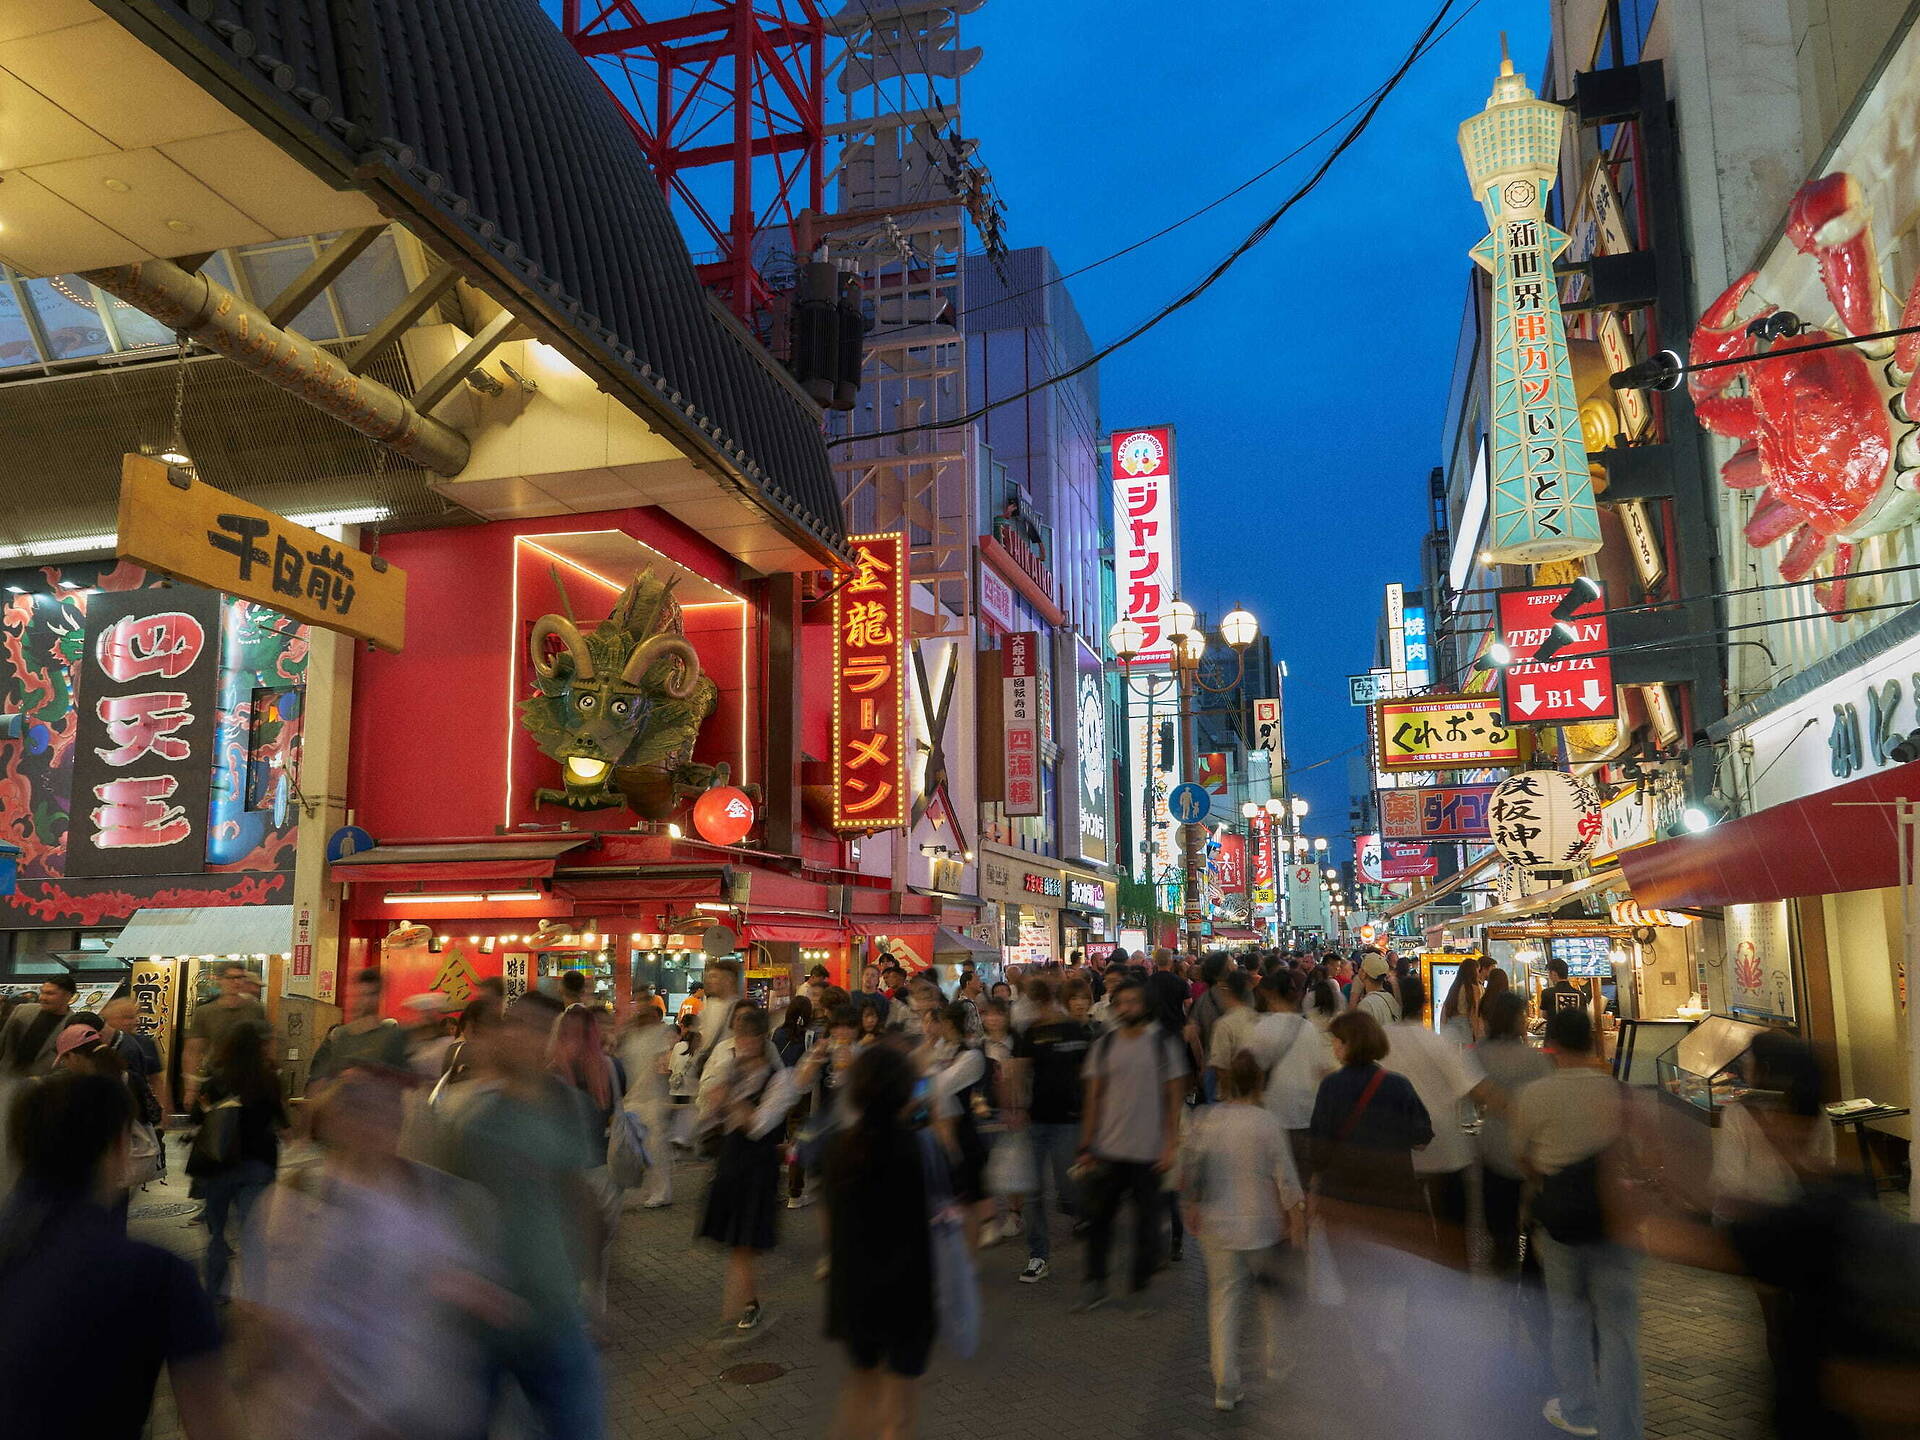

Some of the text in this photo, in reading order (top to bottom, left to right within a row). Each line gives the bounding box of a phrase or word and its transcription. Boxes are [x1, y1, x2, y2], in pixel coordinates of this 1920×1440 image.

[207, 513, 356, 615] 千日前
[1527, 593, 1568, 606] TEPPA
[1404, 617, 1427, 662] 焼肉
[1507, 623, 1602, 648] TEPAN
[842, 545, 893, 814] 金龍ラーメン
[1545, 690, 1575, 709] B1
[89, 611, 205, 849] 四天王
[1392, 711, 1510, 753] くれおーる
[724, 797, 750, 819] 金
[1382, 792, 1417, 825] 薬
[1491, 776, 1554, 868] 鉄板神社
